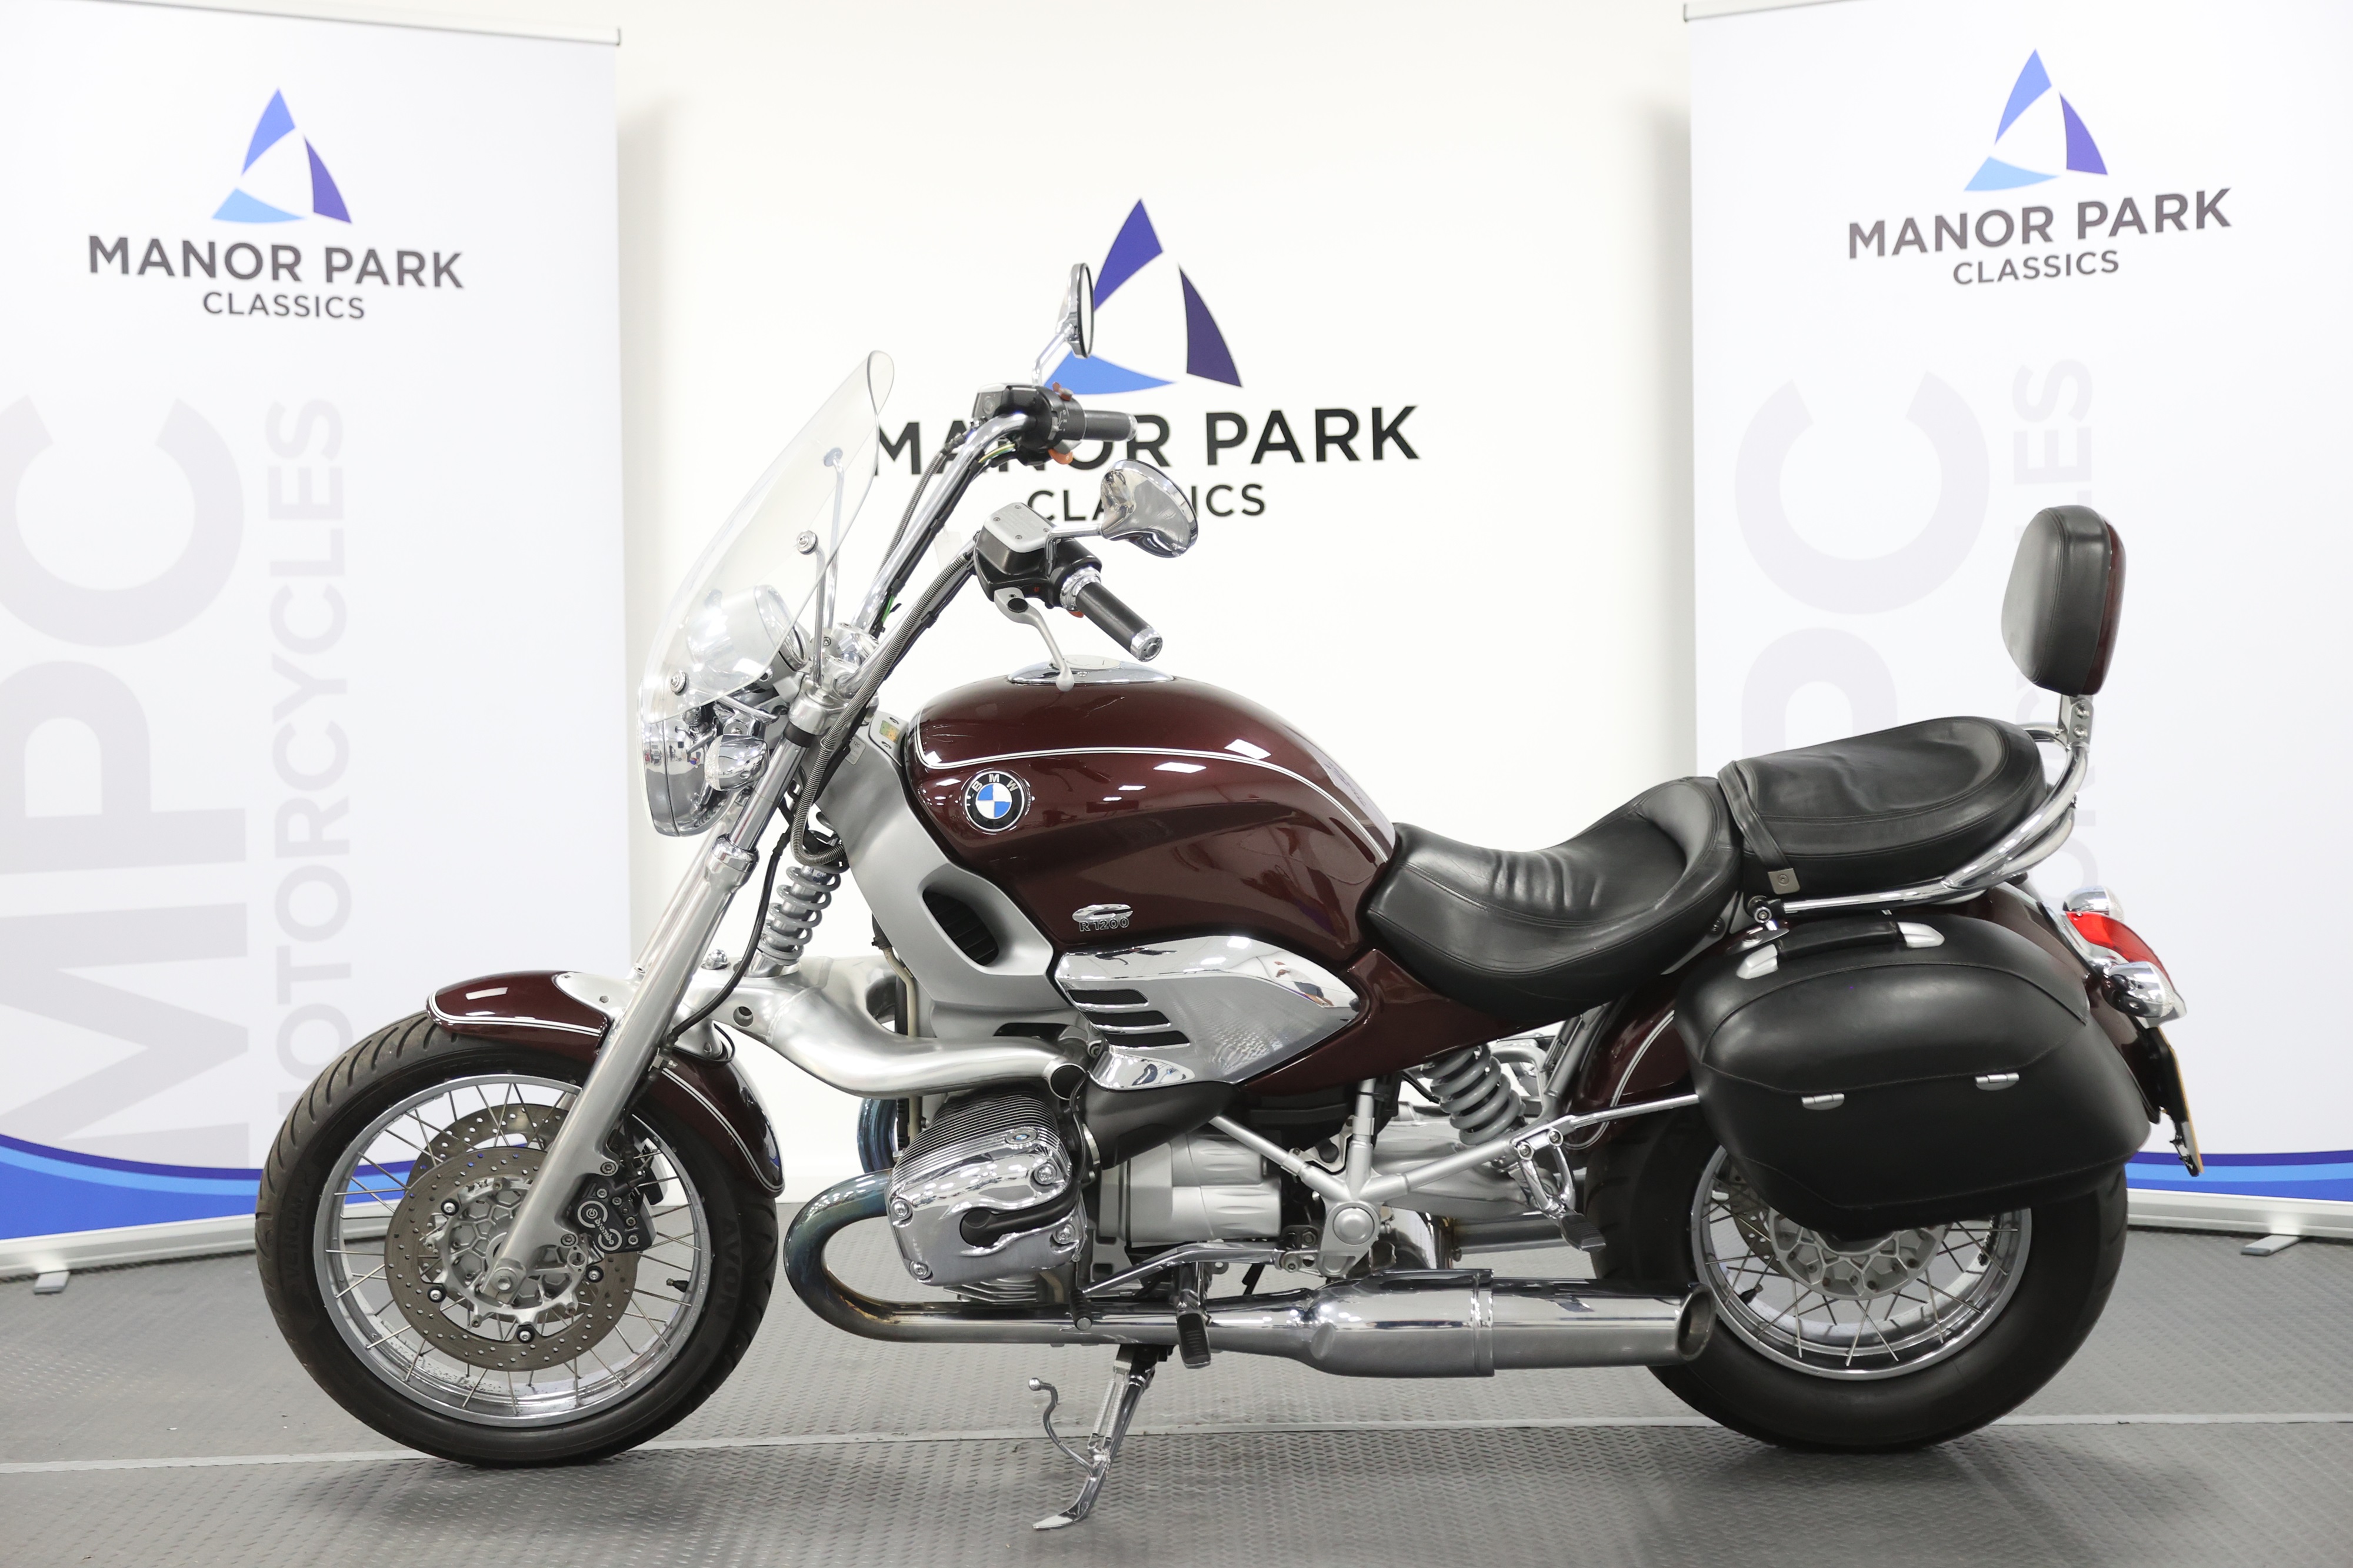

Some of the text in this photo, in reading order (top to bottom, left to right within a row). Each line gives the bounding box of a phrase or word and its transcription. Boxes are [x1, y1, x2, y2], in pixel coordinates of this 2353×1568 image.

[1849, 188, 2232, 259] MANOR PARK
[89, 235, 464, 289] MANOR PARK
[1952, 249, 2119, 285] CLASSICS
[202, 291, 365, 319] CLASSICS
[1206, 406, 1419, 466] PARK
[1027, 483, 1265, 522] CLICS
[971, 773, 1019, 792] BMW
[1079, 917, 1129, 932] R 1200
[594, 1217, 615, 1245] brembo
[714, 1216, 741, 1321] AVON
